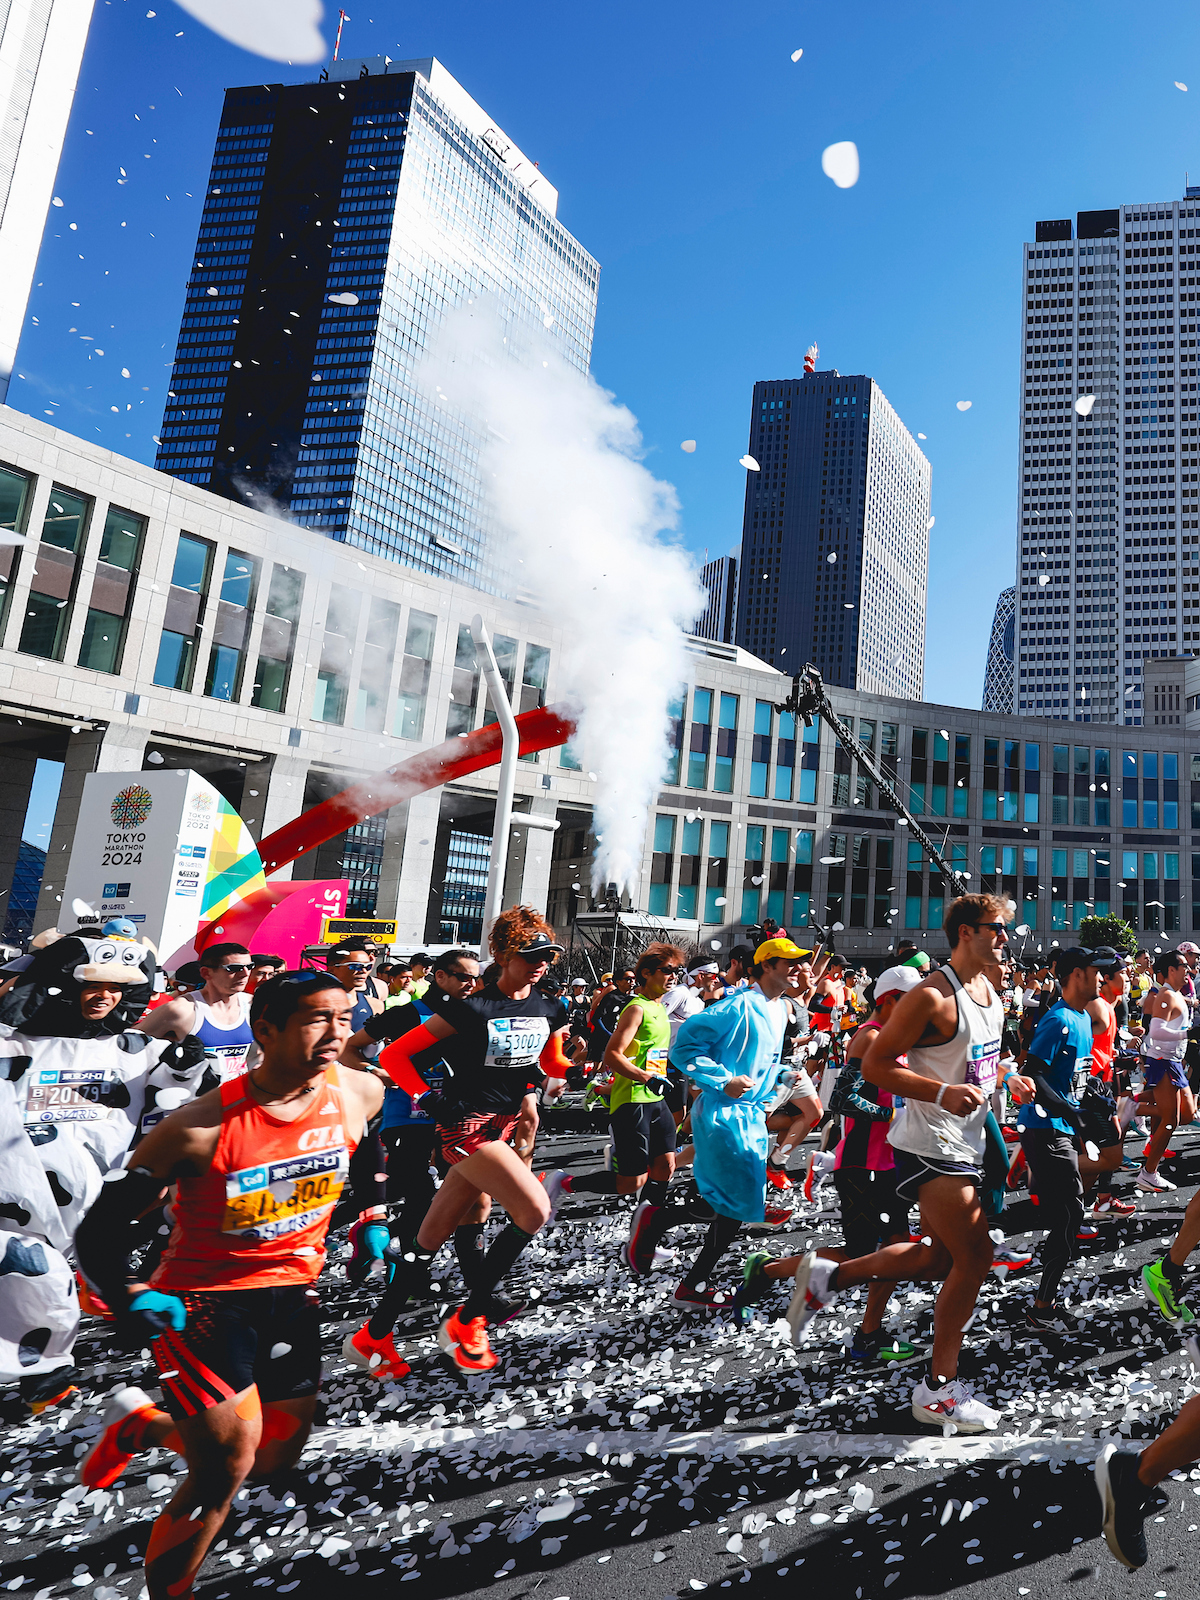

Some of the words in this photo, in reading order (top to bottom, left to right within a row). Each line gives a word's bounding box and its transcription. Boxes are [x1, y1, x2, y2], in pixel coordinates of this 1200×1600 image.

[189, 812, 211, 820] TOKYO
[186, 821, 209, 830] 2024
[106, 832, 146, 844] TOKYO
[101, 852, 142, 866] 2024
[322, 888, 342, 919] ST
[504, 1033, 542, 1050] 53003
[62, 1072, 103, 1081] 東京メトロ
[32, 1088, 44, 1098] B
[54, 1109, 99, 1121] STARTS
